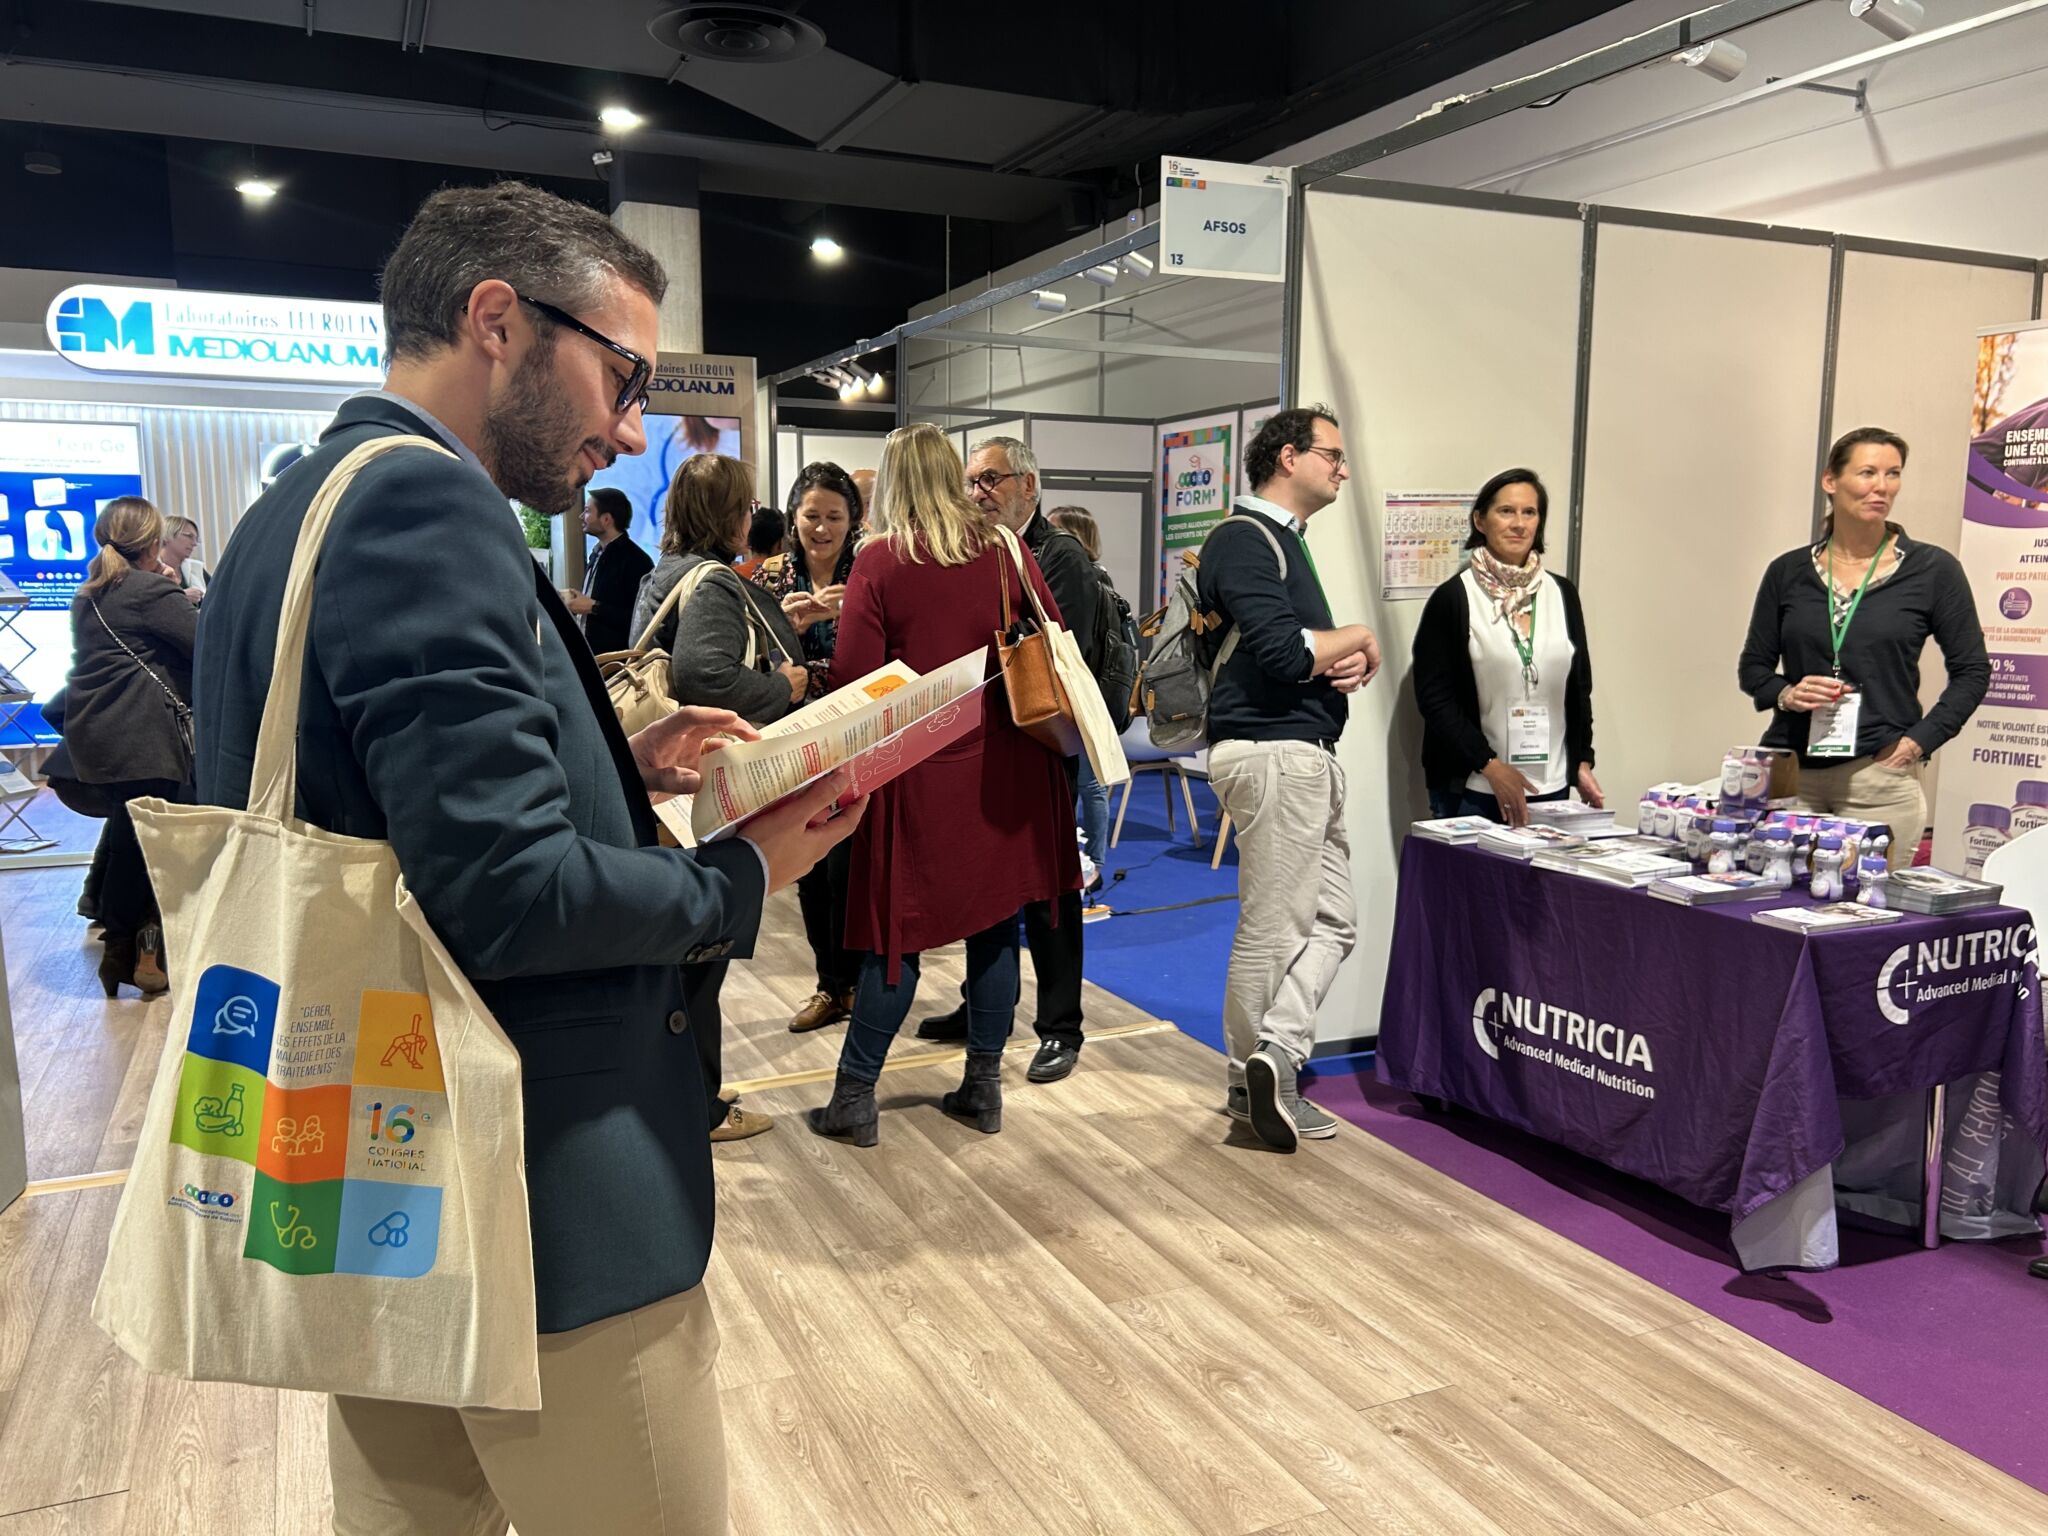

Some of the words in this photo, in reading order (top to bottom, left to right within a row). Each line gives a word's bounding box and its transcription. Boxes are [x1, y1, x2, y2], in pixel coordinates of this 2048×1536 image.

[1203, 220, 1246, 234] AFSOS
[1170, 253, 1184, 265] 13
[169, 335, 379, 367] MEDIOLANUM
[2004, 444, 2028, 457] UNE
[1996, 572, 2014, 580] POUR
[2015, 572, 2027, 580] CES
[1977, 720, 2000, 730] NOTRE
[2002, 722, 2035, 733] VOLONTÉ
[1990, 734, 2004, 742] AUX
[2006, 735, 2039, 746] PATIENTS
[1916, 977, 1969, 1002] Advanced
[290, 1018, 336, 1033] ENSEMBLE
[1502, 991, 1653, 1072] NUTRICIA
[292, 1035, 322, 1048] EFFETS
[323, 1033, 334, 1045] DE
[335, 1032, 346, 1044] LA
[276, 1048, 314, 1063] MALADIE
[315, 1049, 325, 1061] ET
[326, 1047, 342, 1060] DES
[1503, 1035, 1551, 1064] Advanced
[1554, 1052, 1595, 1080] Medical
[1597, 1068, 1655, 1099] Nutrition
[367, 1158, 426, 1171] NATIONAL
